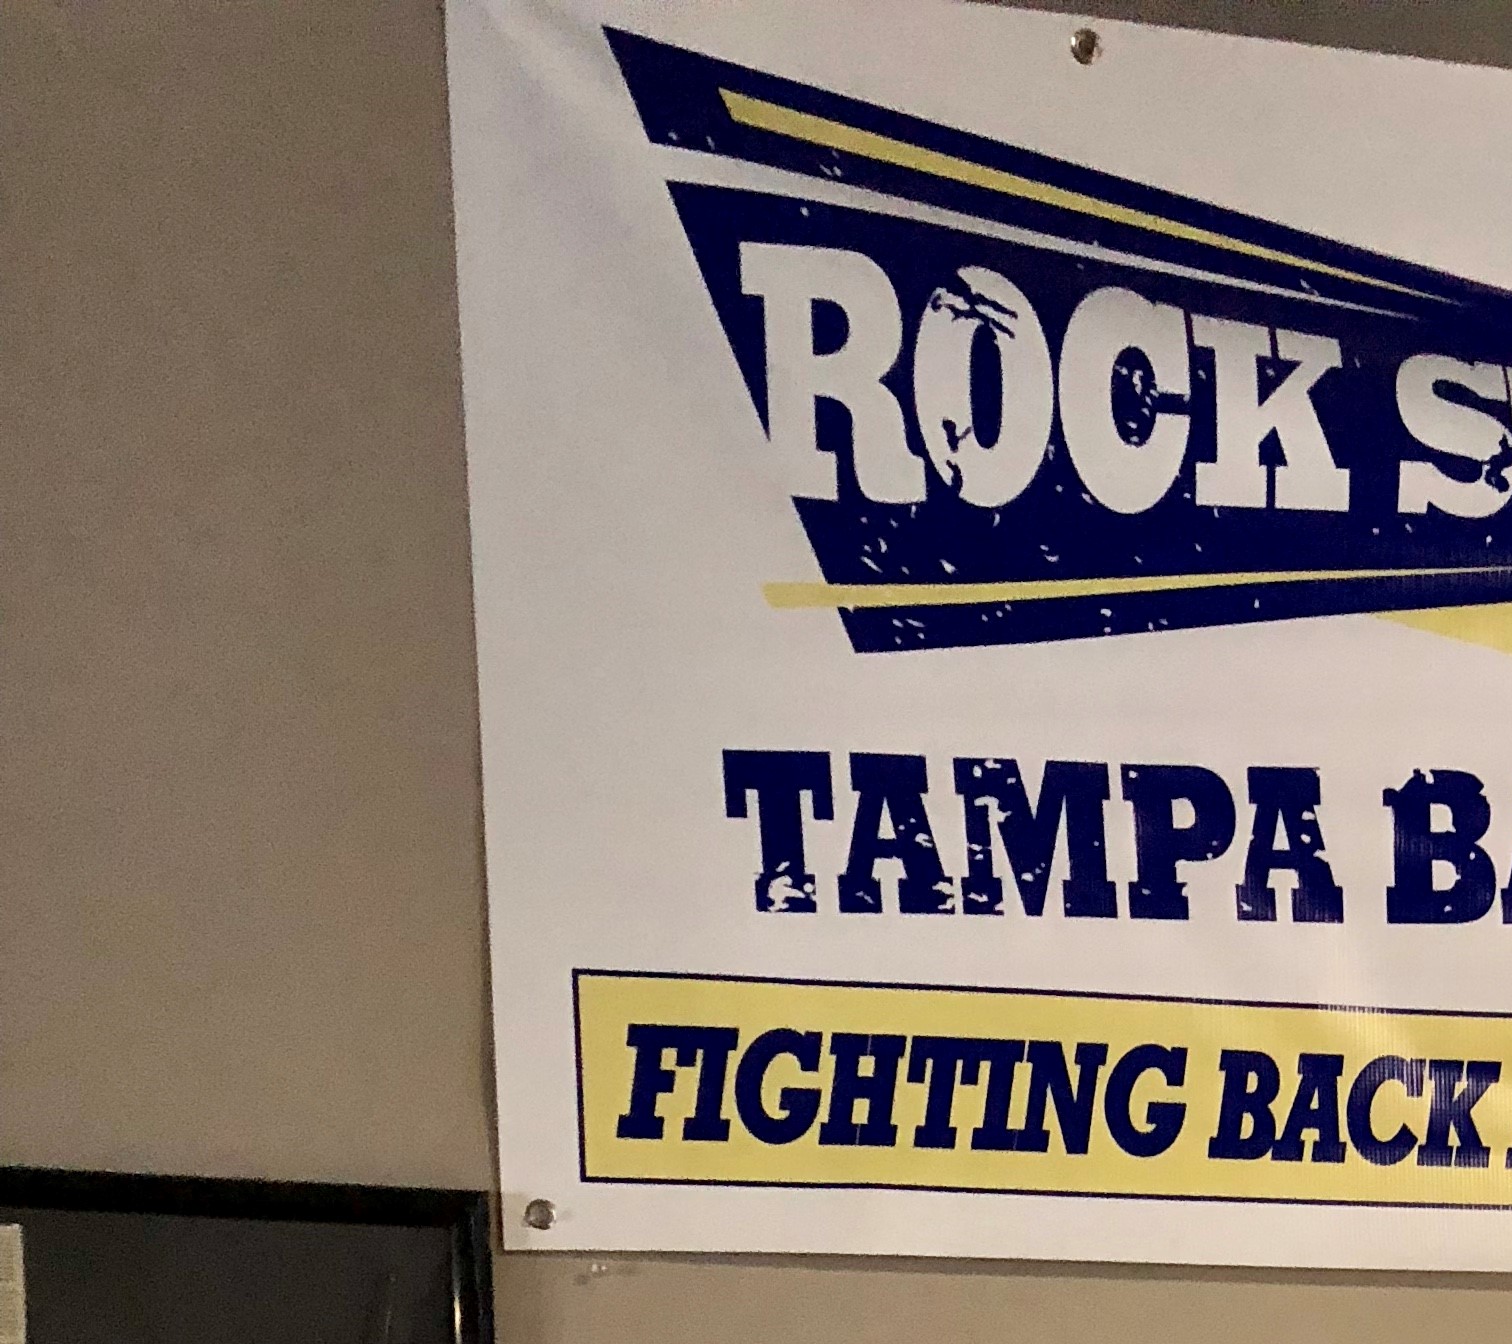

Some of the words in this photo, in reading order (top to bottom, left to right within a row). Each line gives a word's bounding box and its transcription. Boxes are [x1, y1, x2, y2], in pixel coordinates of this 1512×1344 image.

[739, 241, 1351, 514] ROCK
[723, 749, 1344, 925] TAMPA
[617, 1023, 1188, 1158] FIGHTING
[1207, 1049, 1502, 1169] BACK
